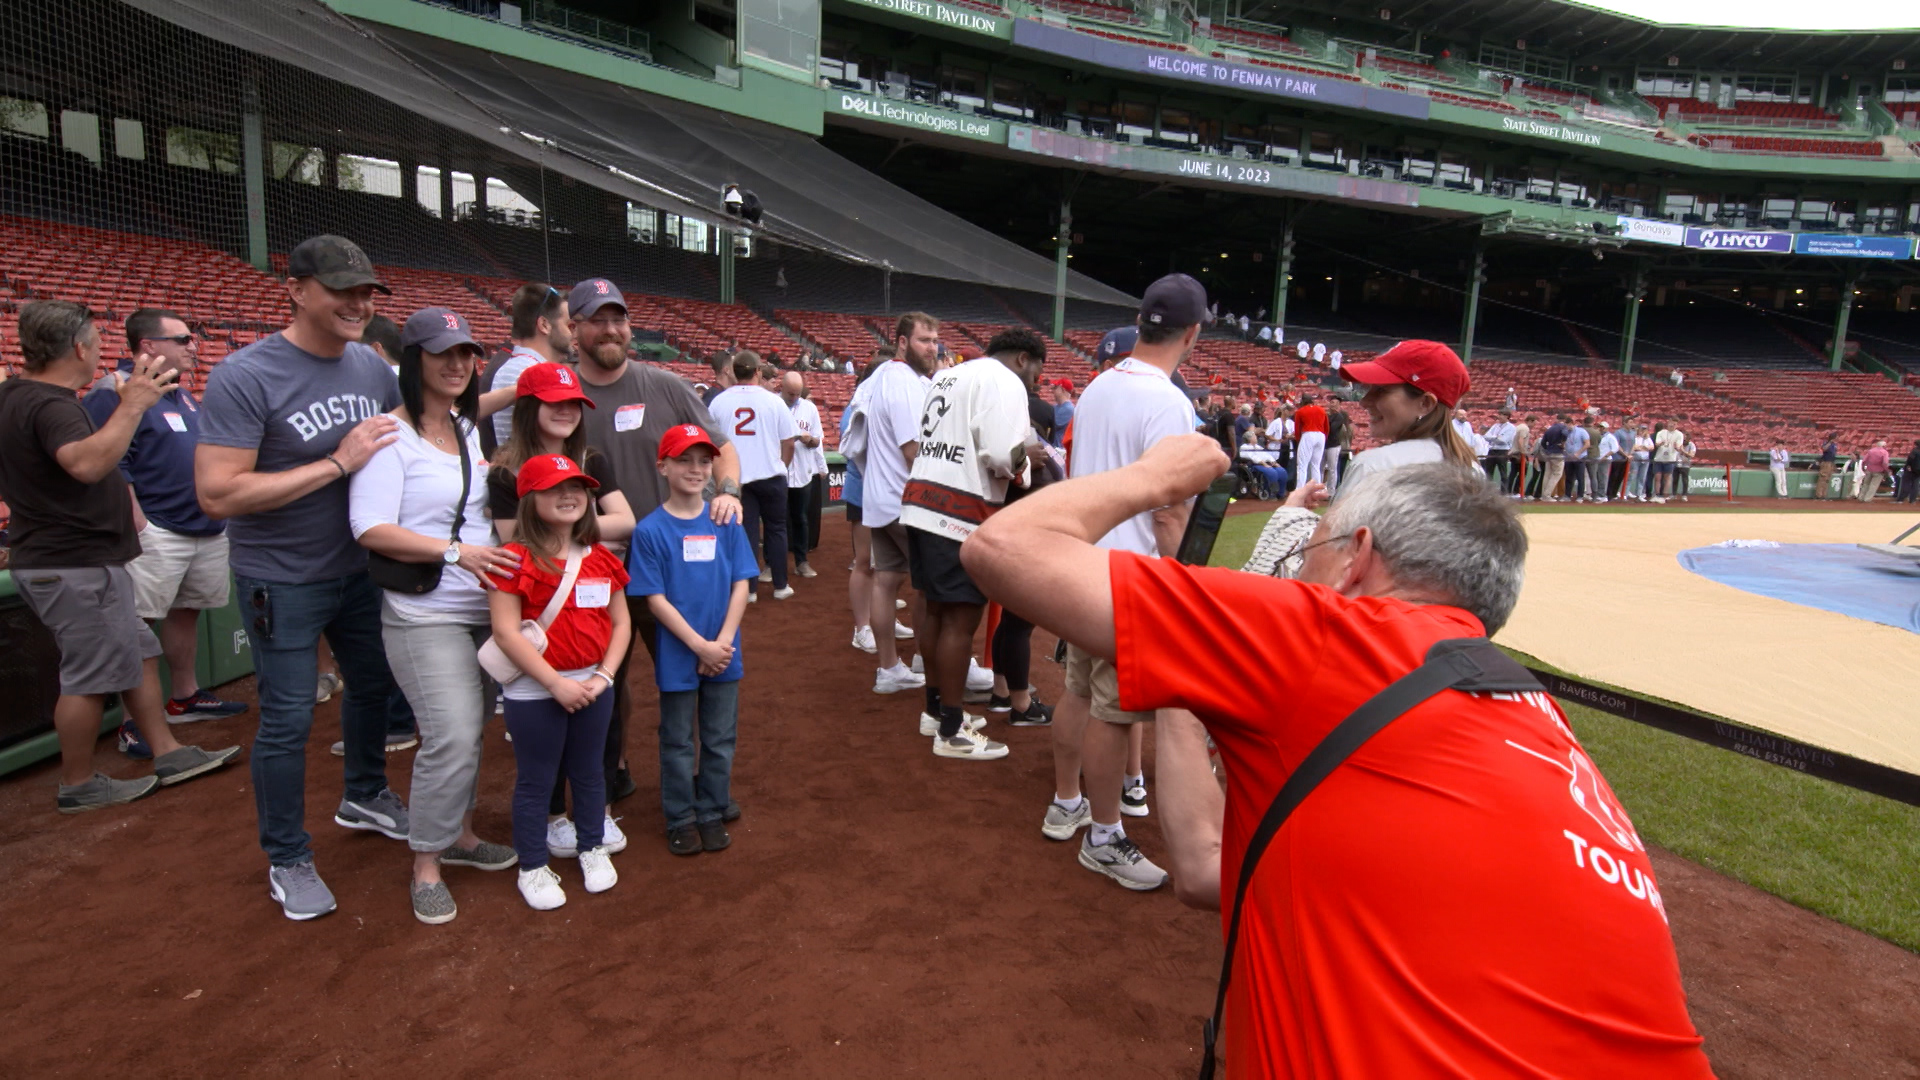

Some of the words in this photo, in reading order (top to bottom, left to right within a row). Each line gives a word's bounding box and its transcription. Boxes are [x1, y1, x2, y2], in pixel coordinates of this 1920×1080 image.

[935, 3, 996, 33] PAVILION
[1147, 55, 1208, 78] WELCOME
[1212, 65, 1228, 80] TO
[1231, 69, 1282, 88] FENWAY
[1285, 79, 1318, 96] PARK
[841, 95, 881, 116] DELL
[880, 103, 958, 132] Technologies
[960, 119, 990, 136] Level
[1502, 117, 1529, 132] STATE
[1529, 121, 1560, 138] STREET
[1561, 127, 1602, 146] PAVILION
[1179, 159, 1212, 176] JUNE
[1216, 163, 1233, 182] 14,
[1237, 167, 1270, 184] 2023
[1721, 233, 1769, 248] HYCU
[734, 407, 756, 436] 2
[1559, 681, 1627, 710] RAVEIS.COM
[1714, 721, 1776, 750] WILLIAM
[1782, 741, 1836, 768] RAVEIS
[1733, 743, 1760, 759] REAL
[1764, 751, 1808, 770] ESTATE
